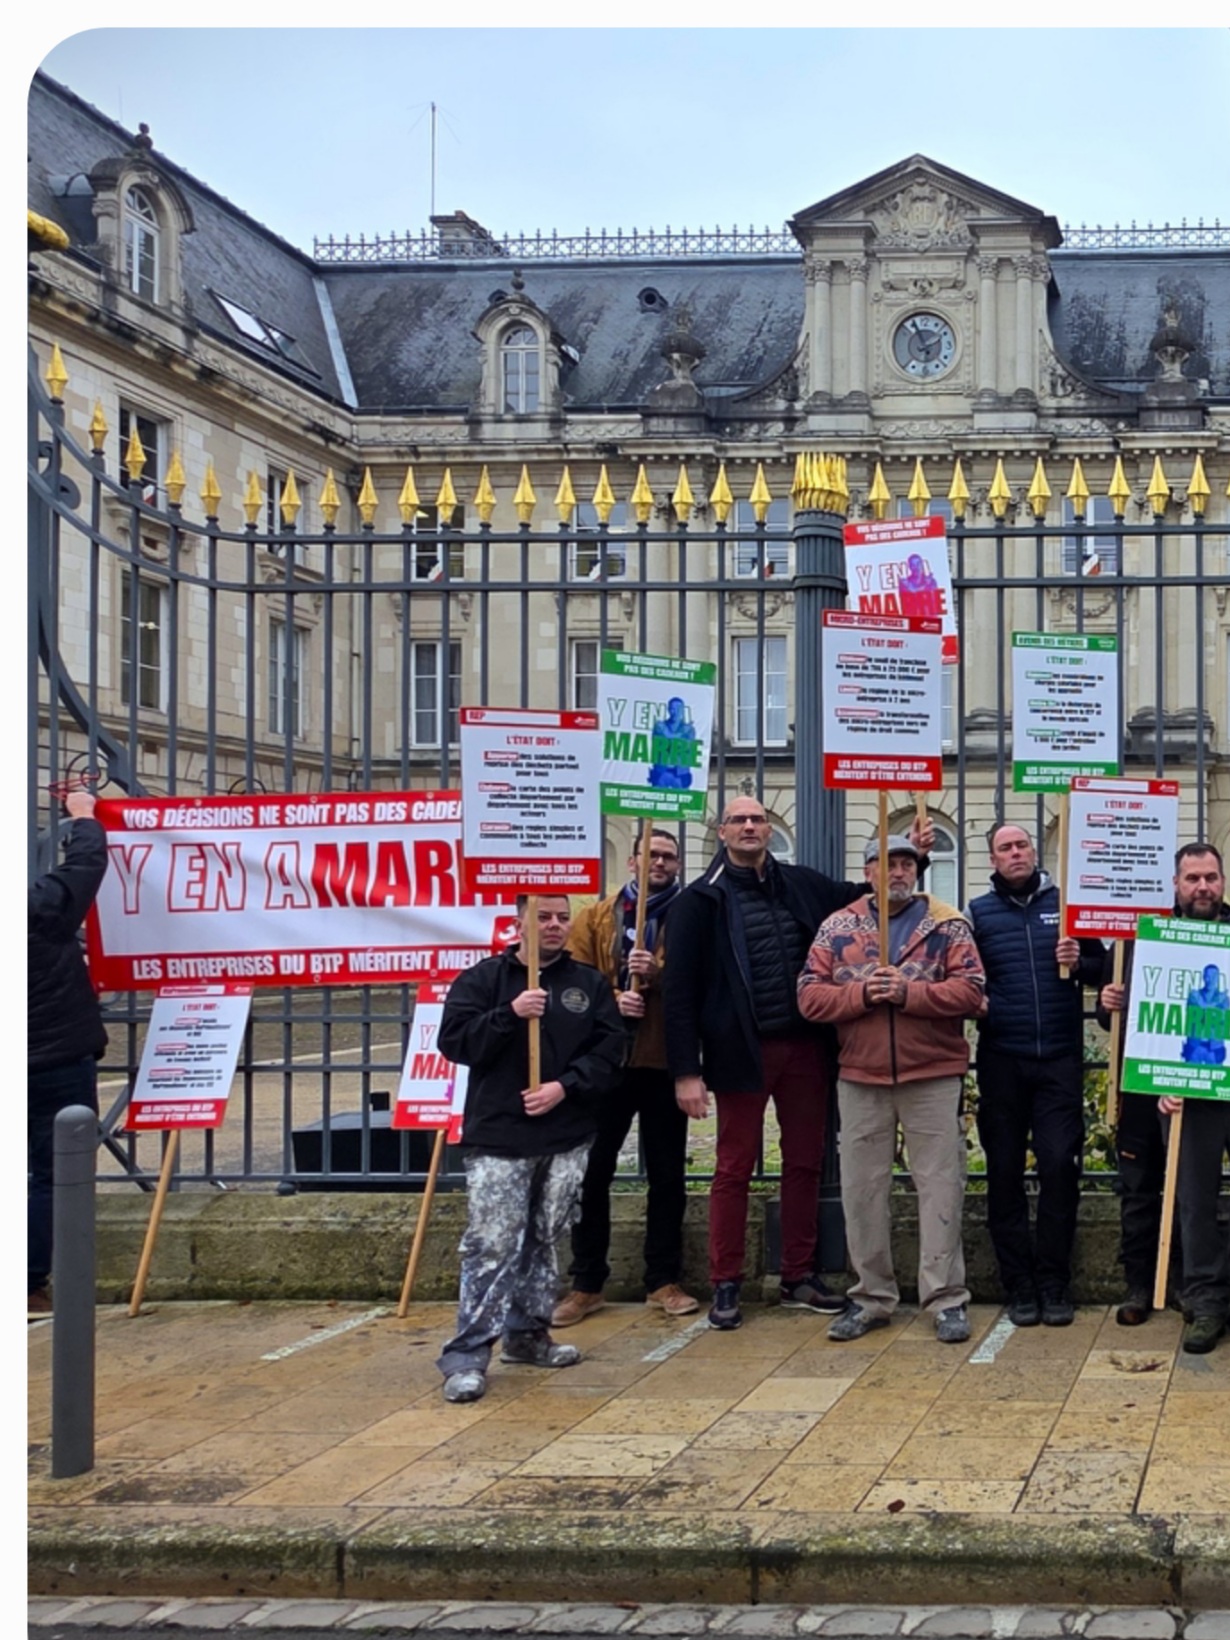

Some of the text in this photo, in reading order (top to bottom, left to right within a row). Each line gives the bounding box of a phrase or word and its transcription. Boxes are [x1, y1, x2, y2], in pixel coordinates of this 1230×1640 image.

[606, 697, 628, 728] Y
[603, 730, 704, 769] MARRE
[122, 808, 159, 829] VOS
[162, 803, 254, 829] DÉCISIONS
[258, 804, 281, 826] NE
[284, 803, 332, 825] SONT
[335, 802, 370, 824] PAS
[374, 801, 408, 823] DES
[412, 800, 462, 822] CADE
[107, 839, 519, 915] Y EN A MAR
[132, 959, 163, 981] LES
[167, 955, 276, 979] ENTREPRISES
[280, 954, 306, 976] DU
[310, 953, 345, 975] BTP
[349, 947, 434, 973] MÉRITENT
[1143, 965, 1164, 998] Y
